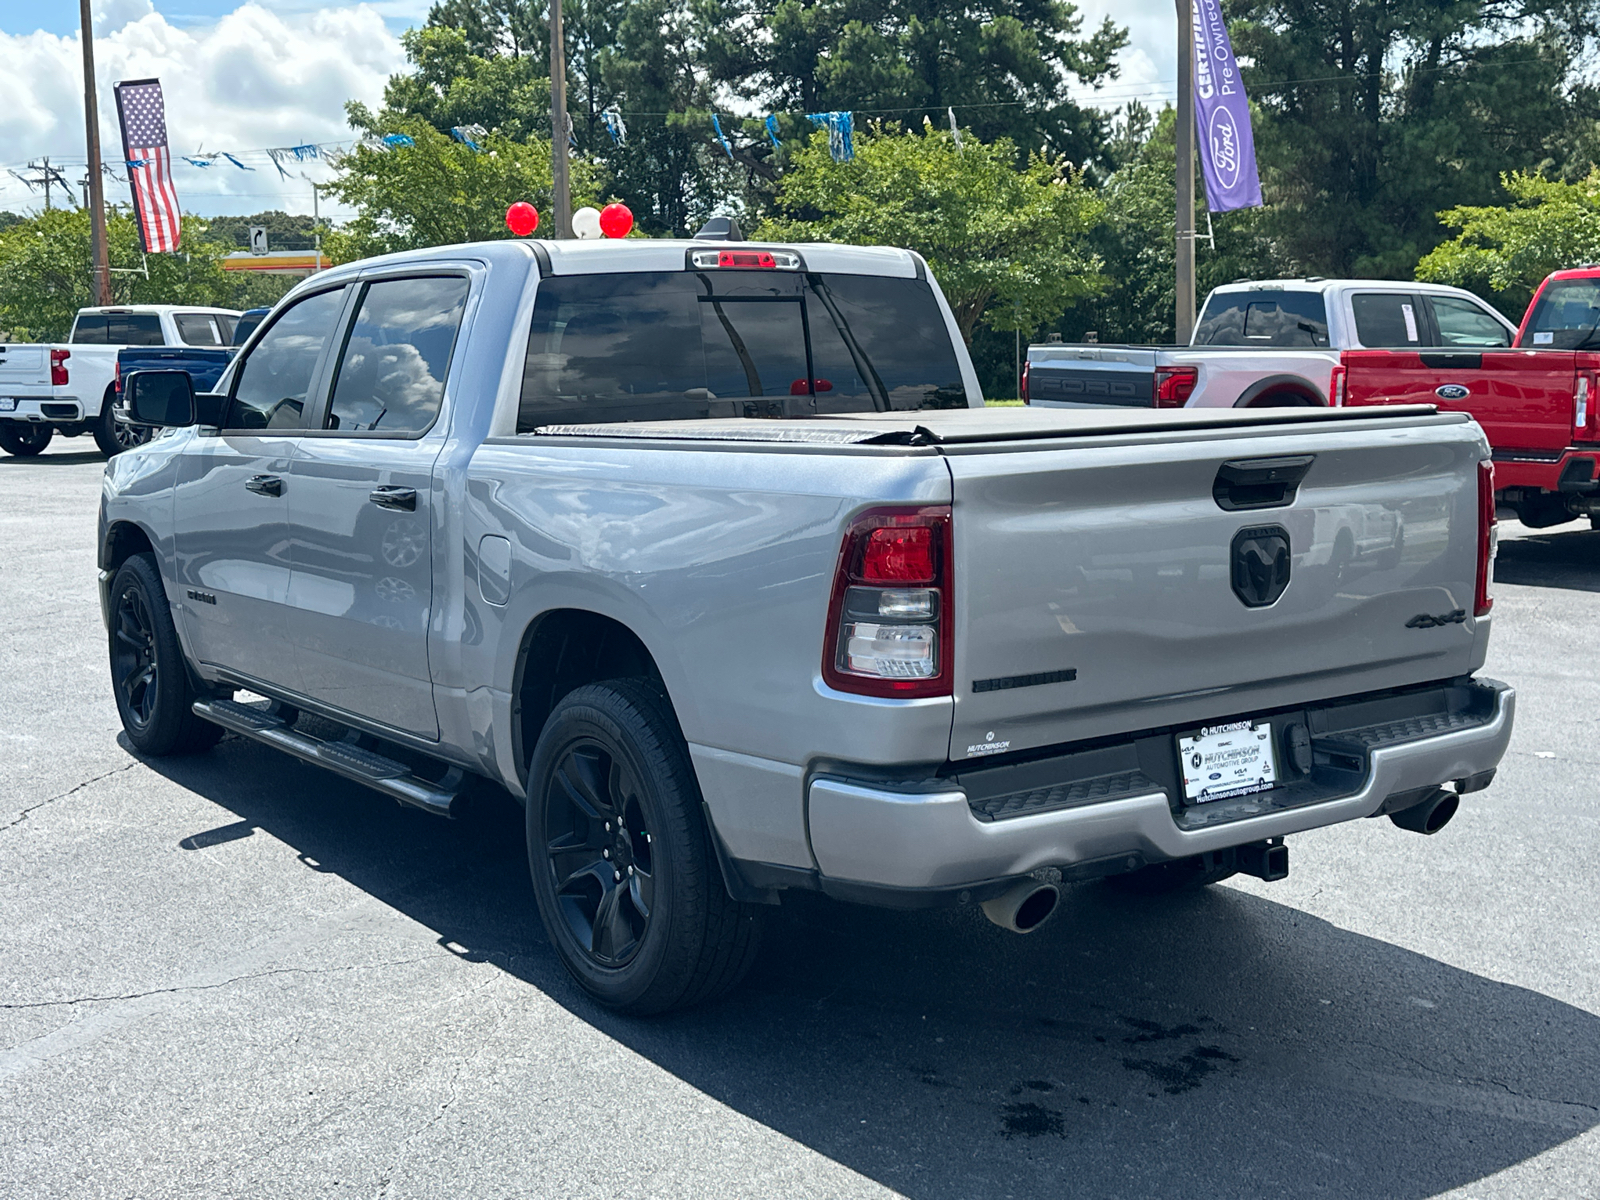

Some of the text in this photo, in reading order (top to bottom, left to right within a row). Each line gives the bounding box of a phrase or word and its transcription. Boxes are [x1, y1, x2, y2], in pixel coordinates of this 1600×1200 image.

[1193, 0, 1214, 99] CERTIFIED
[1205, 0, 1236, 96] Pre-Owned
[1214, 123, 1236, 172] Ford
[1040, 379, 1136, 396] FORD
[1247, 527, 1280, 537] RAM
[1209, 720, 1252, 735] HUTCHINSON
[967, 741, 1010, 753] HUTCHINSON
[1204, 745, 1261, 765] HUTCHINSON
[1206, 756, 1259, 771] AUTOMOTIVE GROUP
[1196, 782, 1274, 804] Hutchinsonautogroup.com
